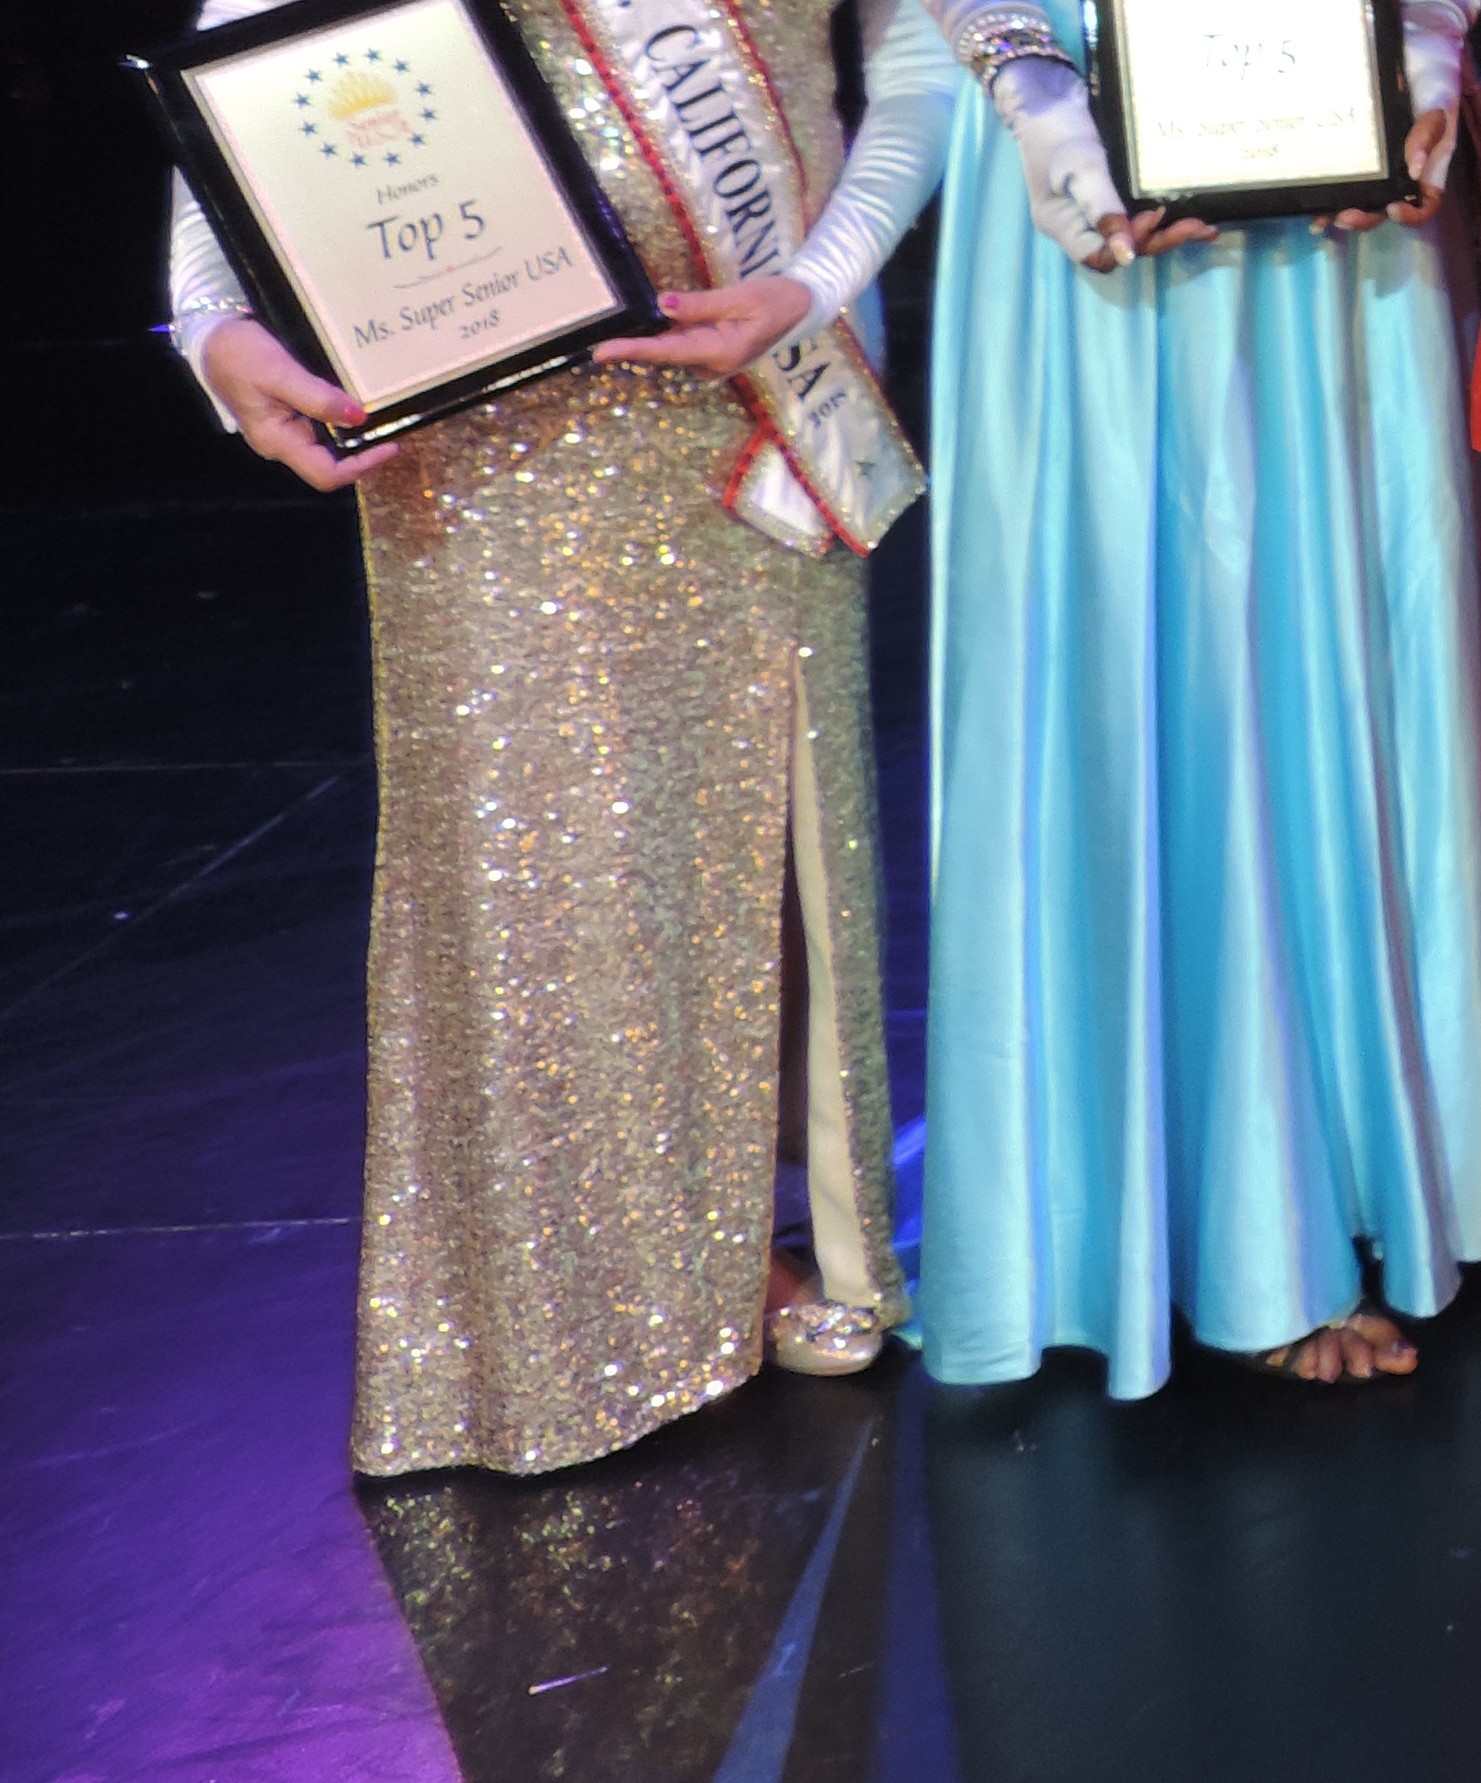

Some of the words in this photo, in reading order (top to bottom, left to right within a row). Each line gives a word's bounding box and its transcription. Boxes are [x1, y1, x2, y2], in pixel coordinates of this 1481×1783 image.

[644, 22, 782, 279] CALIFORNI
[376, 174, 439, 204] Honors
[367, 212, 443, 260] Top
[459, 199, 486, 240] 5
[353, 319, 396, 348] Ms.
[400, 294, 455, 331] Super
[461, 270, 519, 307] Senior
[524, 246, 574, 282] USA
[459, 308, 501, 340] 2018
